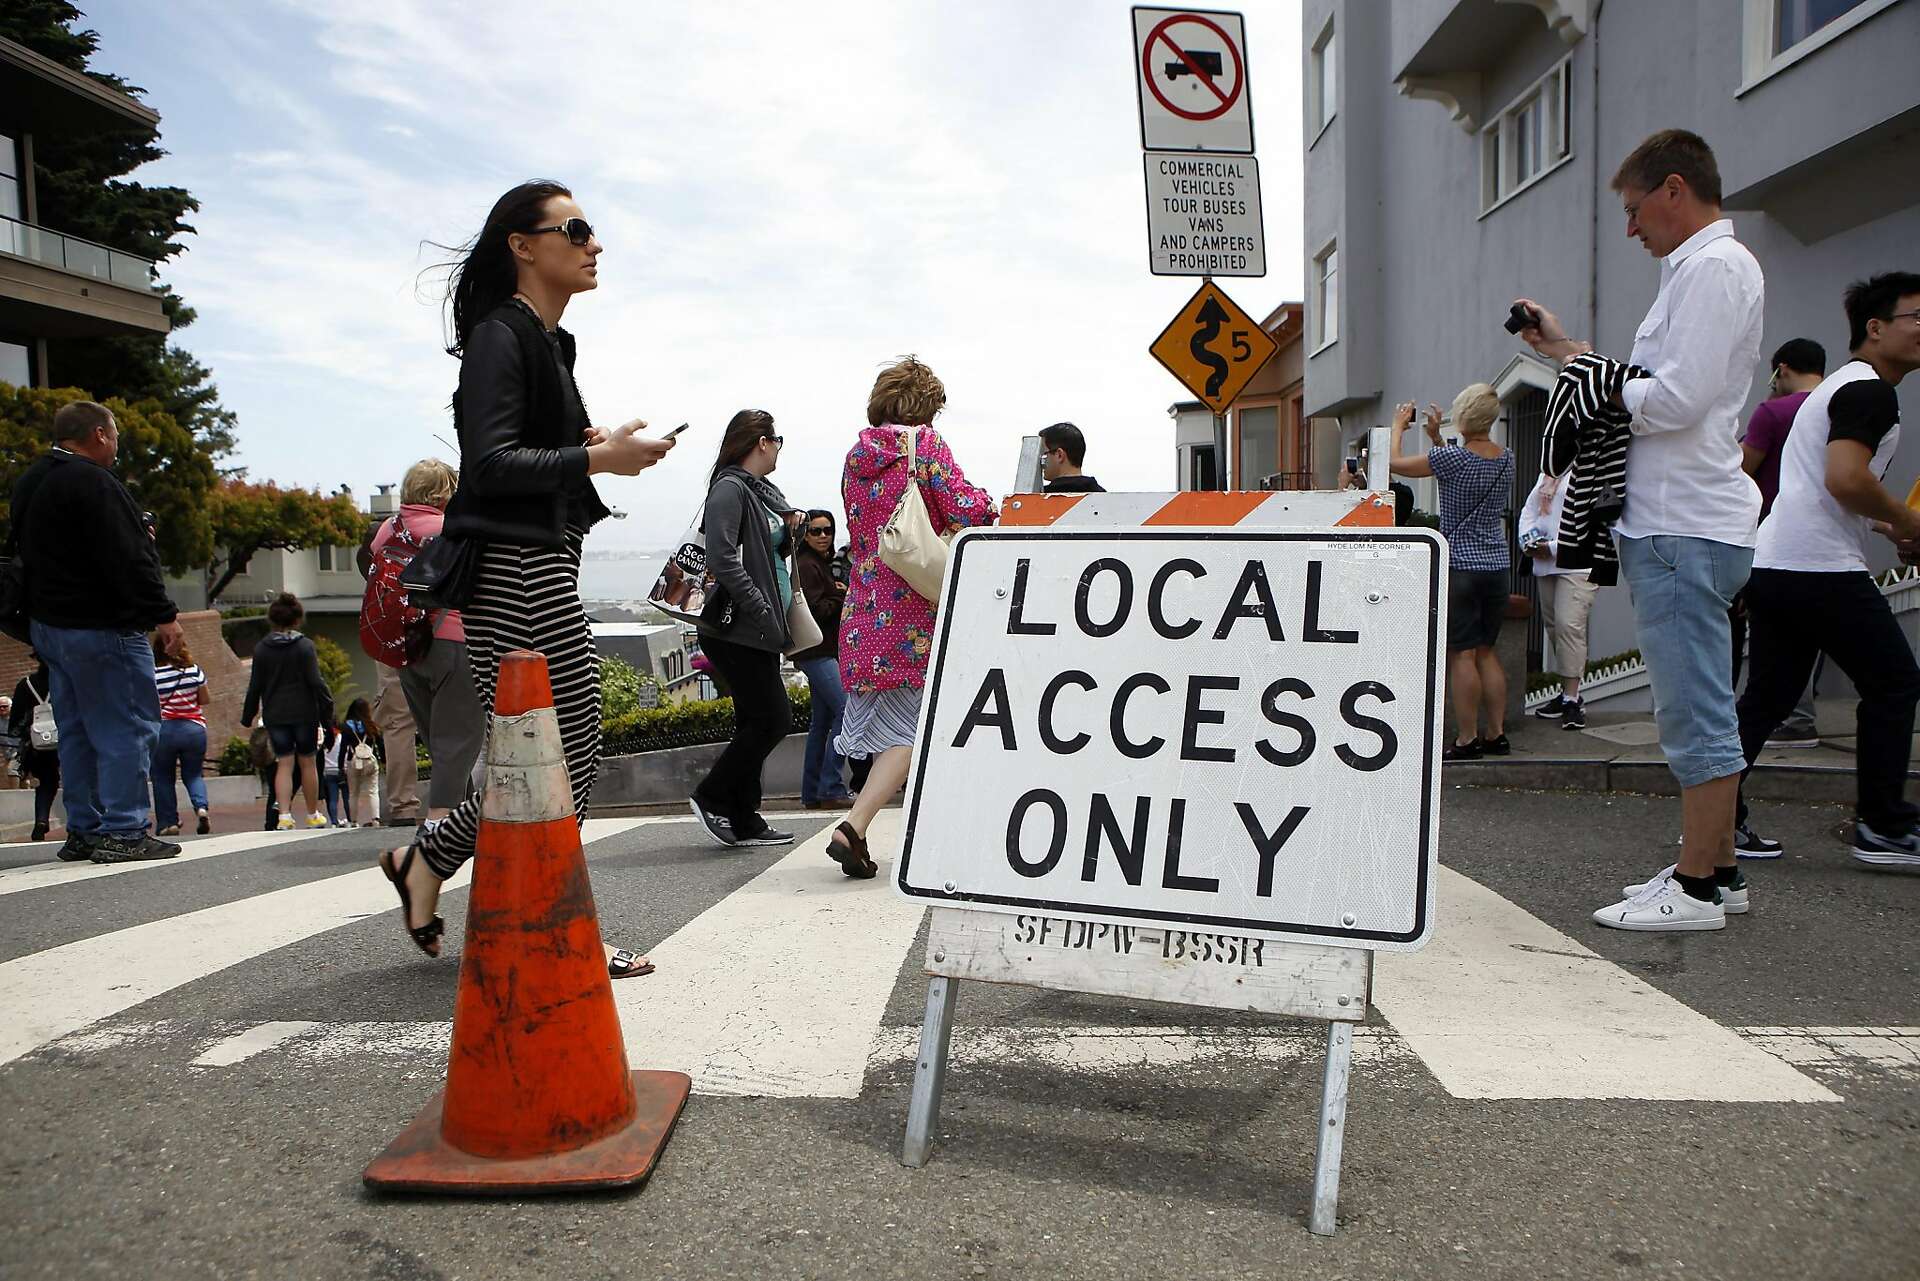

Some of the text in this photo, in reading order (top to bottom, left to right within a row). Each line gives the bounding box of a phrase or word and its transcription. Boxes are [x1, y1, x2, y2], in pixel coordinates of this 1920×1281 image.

[1160, 161, 1244, 178] COMMERCIAL
[1172, 180, 1235, 196] VEHICLES
[1163, 198, 1246, 215] TOUR BUSES
[1188, 218, 1224, 233] VANS
[1160, 235, 1255, 251] AND CAMPERS
[1169, 253, 1247, 270] PROHIBITED
[1231, 331, 1252, 362] 5
[1379, 543, 1411, 551] CORNER
[1006, 557, 1359, 644] LOCAL
[950, 668, 1398, 772] ACCESS
[1005, 788, 1312, 897] ONLY
